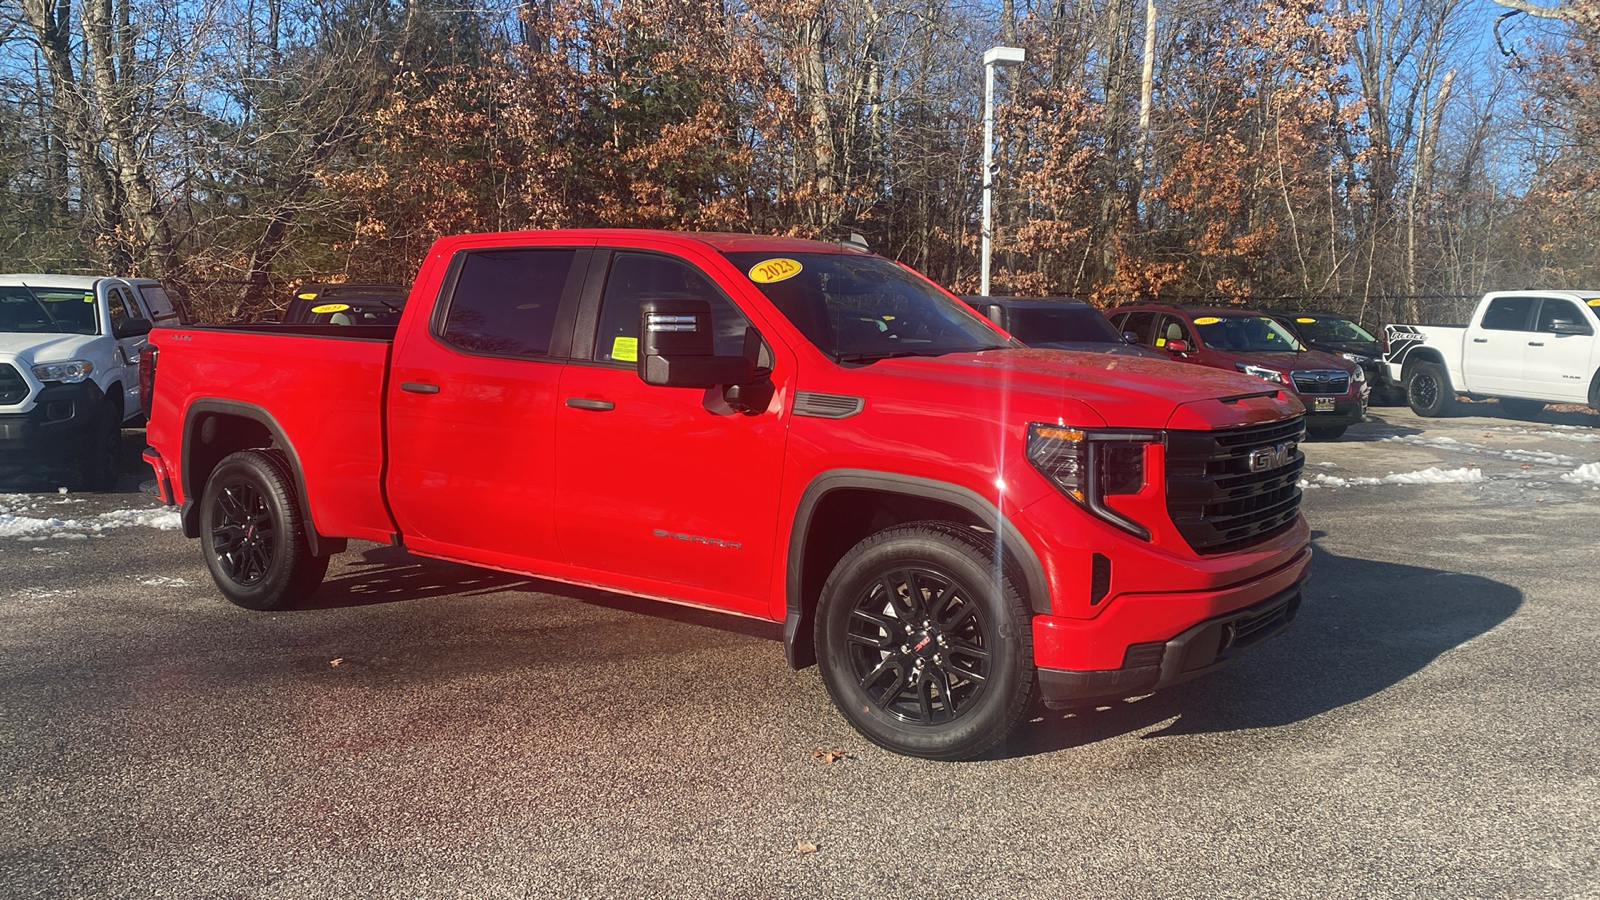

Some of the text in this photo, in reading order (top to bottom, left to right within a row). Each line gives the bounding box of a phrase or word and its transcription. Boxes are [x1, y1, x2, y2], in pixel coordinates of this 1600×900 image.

[759, 260, 794, 280] 2023
[1249, 440, 1298, 472] GMC
[653, 529, 742, 550] SIERRA
